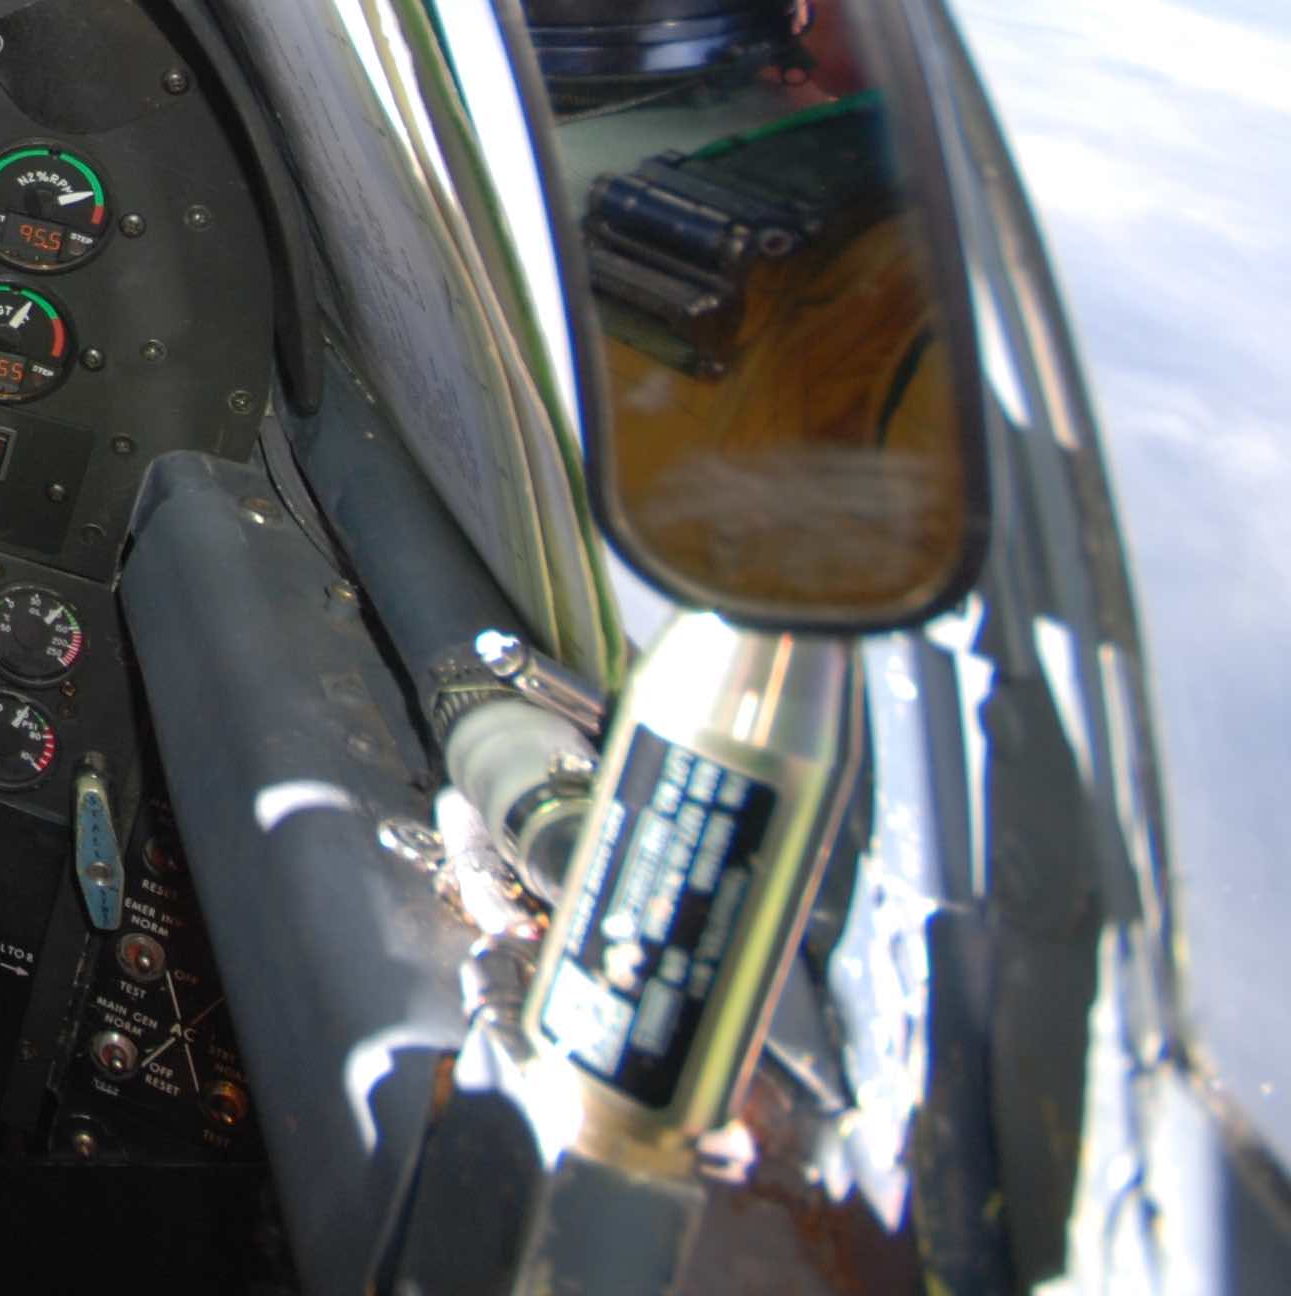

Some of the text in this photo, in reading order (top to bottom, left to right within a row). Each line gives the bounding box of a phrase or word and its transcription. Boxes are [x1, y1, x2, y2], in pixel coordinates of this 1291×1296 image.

[69, 232, 95, 245] STEP
[31, 363, 55, 378] STEP
[123, 897, 157, 920] EMER
[131, 914, 171, 938] NORM
[119, 980, 148, 1001] TEST
[96, 996, 159, 1032] MAIN GEN
[103, 1013, 143, 1038] NORM
[169, 1022, 197, 1044] AC
[148, 1061, 174, 1080] OFF
[144, 1073, 181, 1098] RESET
